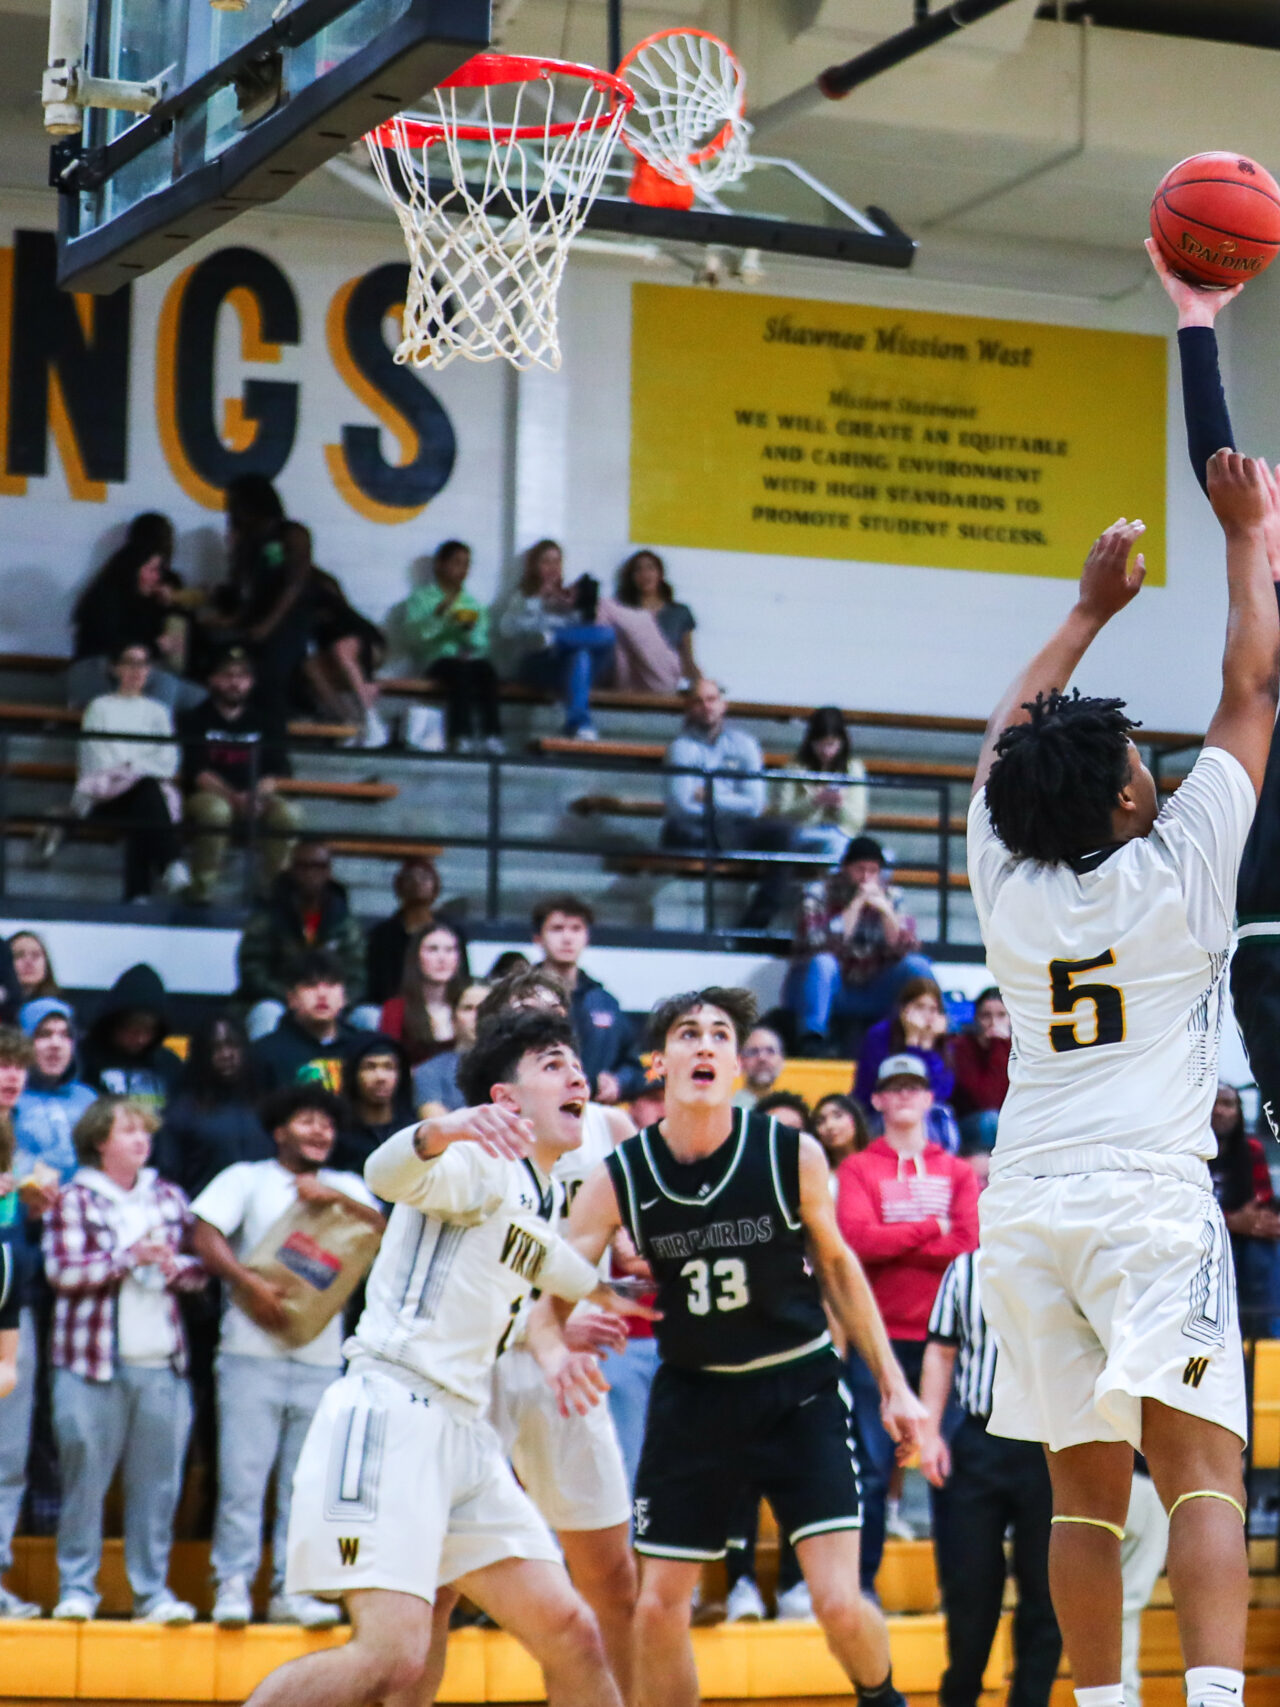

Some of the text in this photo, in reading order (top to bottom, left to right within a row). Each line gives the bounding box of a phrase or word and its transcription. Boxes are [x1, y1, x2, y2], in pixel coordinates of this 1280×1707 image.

[1177, 231, 1263, 272] SPALDING
[763, 314, 1034, 367] Shawnee Mission West
[829, 389, 977, 420] Mission Statement
[735, 410, 1068, 456] WE WILL CREATE AN EQUITABLE
[761, 445, 1042, 483] AND CARING ENVIRONMENT
[763, 476, 1041, 514] WITH HIGH STANDARDS TO
[752, 506, 850, 529] PROMOTE
[859, 514, 949, 536] STUDENT
[1048, 946, 1127, 1053] 5
[679, 1257, 750, 1317] 33
[1182, 1356, 1210, 1389] W
[337, 1536, 360, 1567] W
